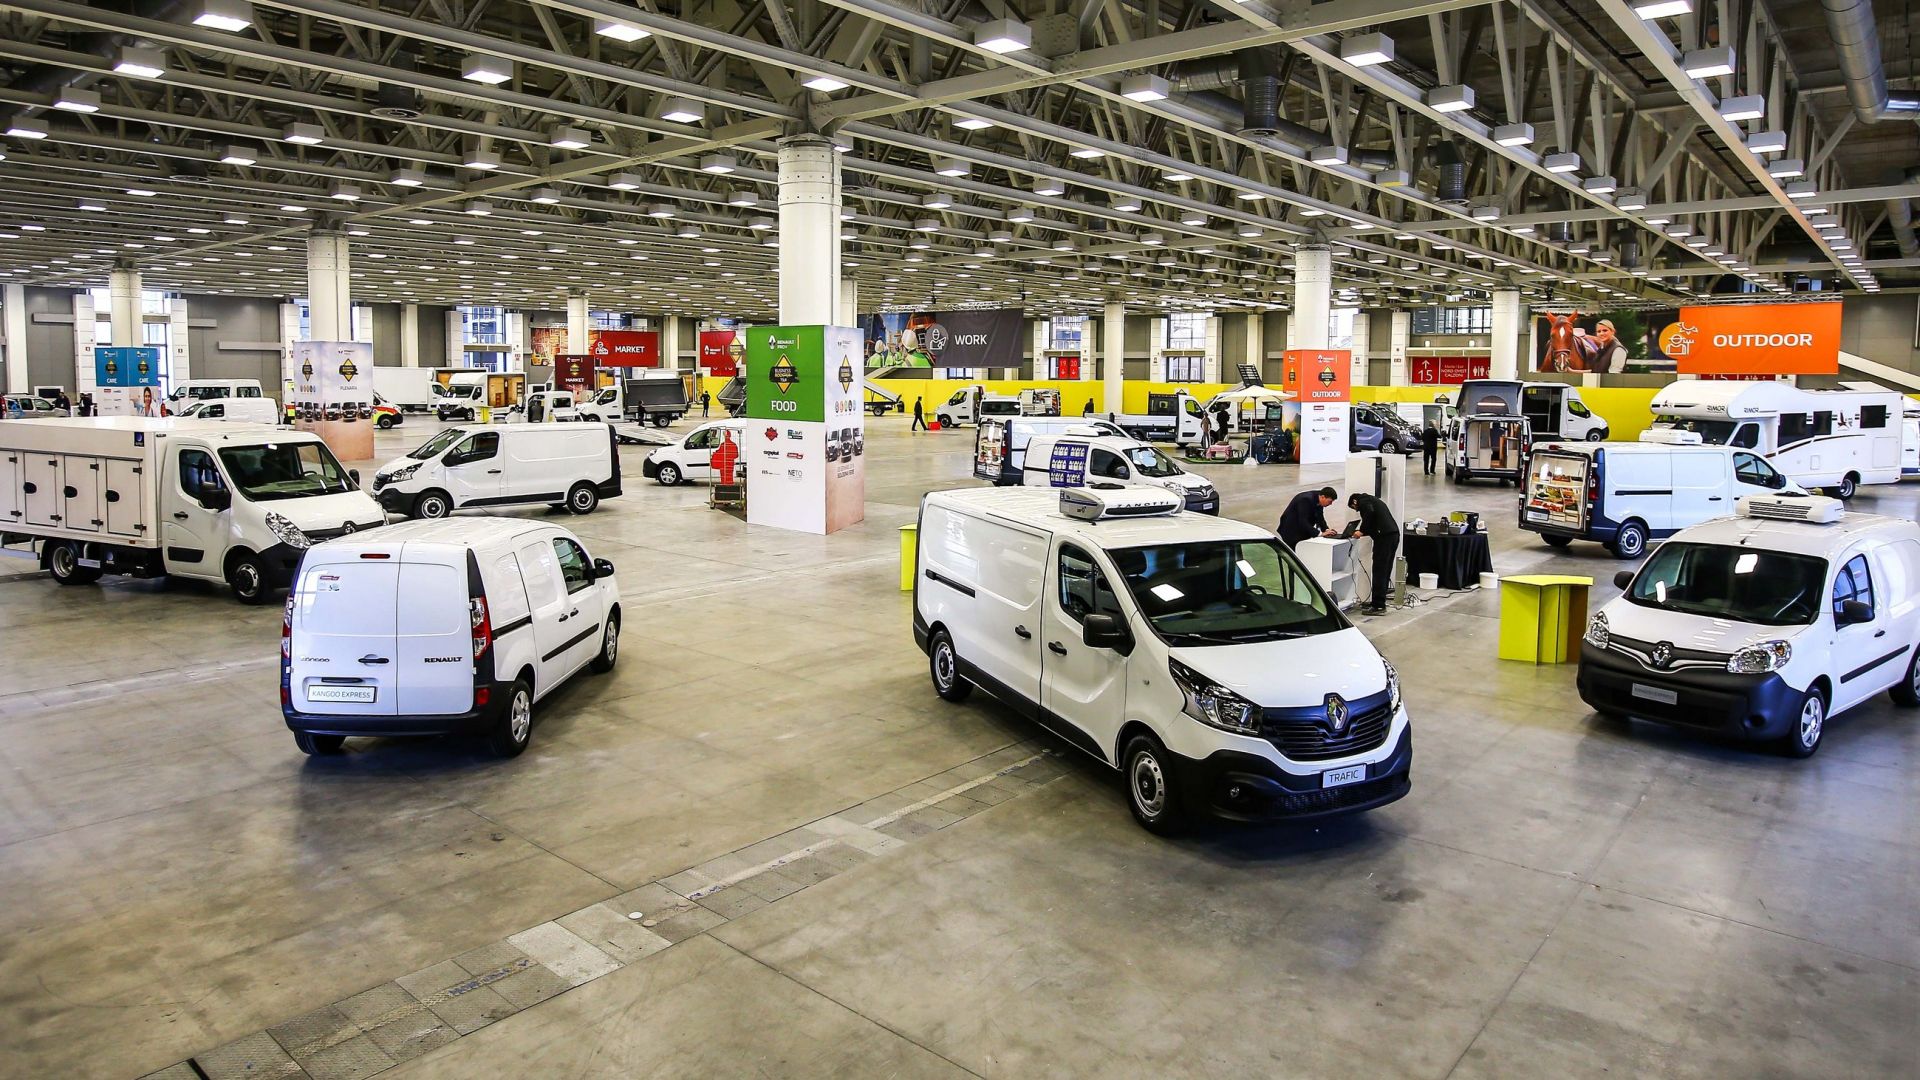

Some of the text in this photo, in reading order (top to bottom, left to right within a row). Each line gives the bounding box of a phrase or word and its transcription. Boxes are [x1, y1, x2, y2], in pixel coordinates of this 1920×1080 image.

[954, 334, 988, 345] WORK
[1713, 334, 1812, 347] OUTDOOR
[615, 345, 645, 354] MARKET
[1418, 369, 1433, 382] 15
[771, 400, 797, 412] FOOD
[312, 690, 340, 698] KANGOO
[1329, 769, 1359, 783] TRAFIC
